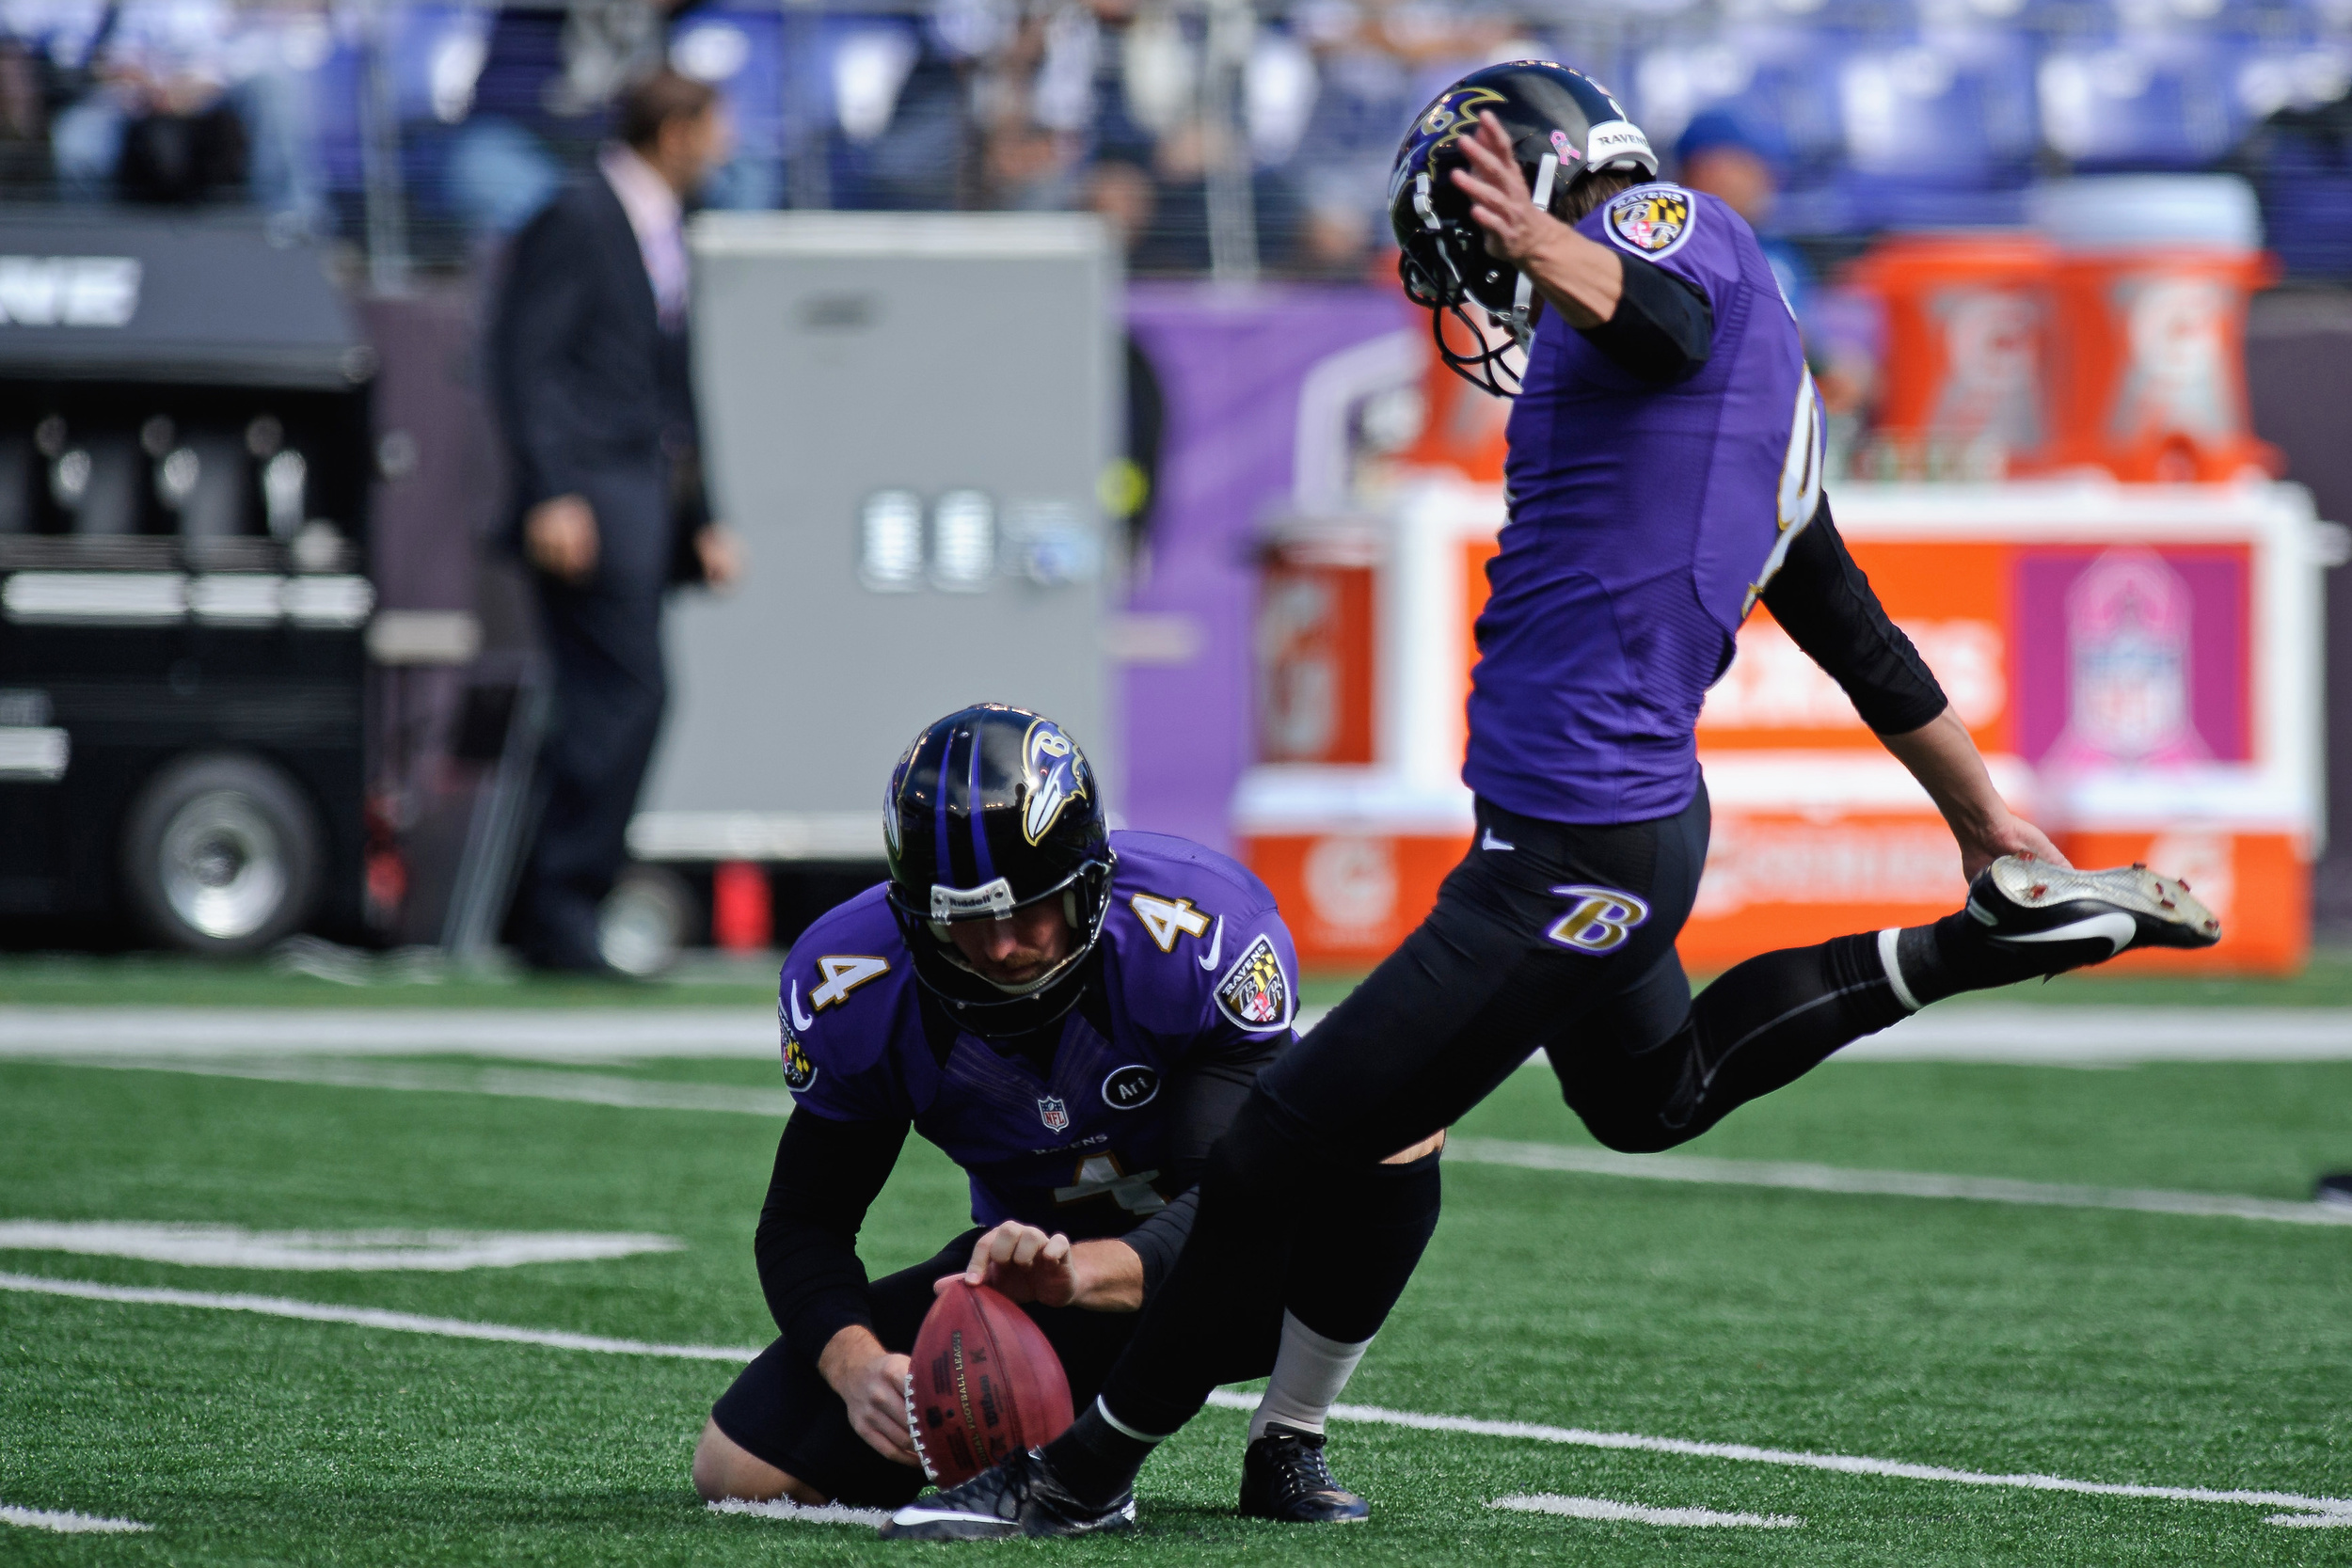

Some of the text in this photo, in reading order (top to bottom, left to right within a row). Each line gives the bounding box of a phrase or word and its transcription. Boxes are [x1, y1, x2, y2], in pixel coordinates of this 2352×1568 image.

[1597, 134, 1649, 149] RAVEN
[1614, 191, 1684, 210] RAVENS
[948, 893, 991, 908] Riddell
[1547, 884, 1651, 954] B
[1130, 893, 1211, 954] 4
[809, 955, 891, 1012] 4
[1223, 943, 1267, 995] RAVENS
[1118, 1077, 1149, 1100] Art
[1044, 1112, 1065, 1126] NFL
[951, 1329, 964, 1371] LEAGUE
[956, 1373, 976, 1430] FOOTBALL
